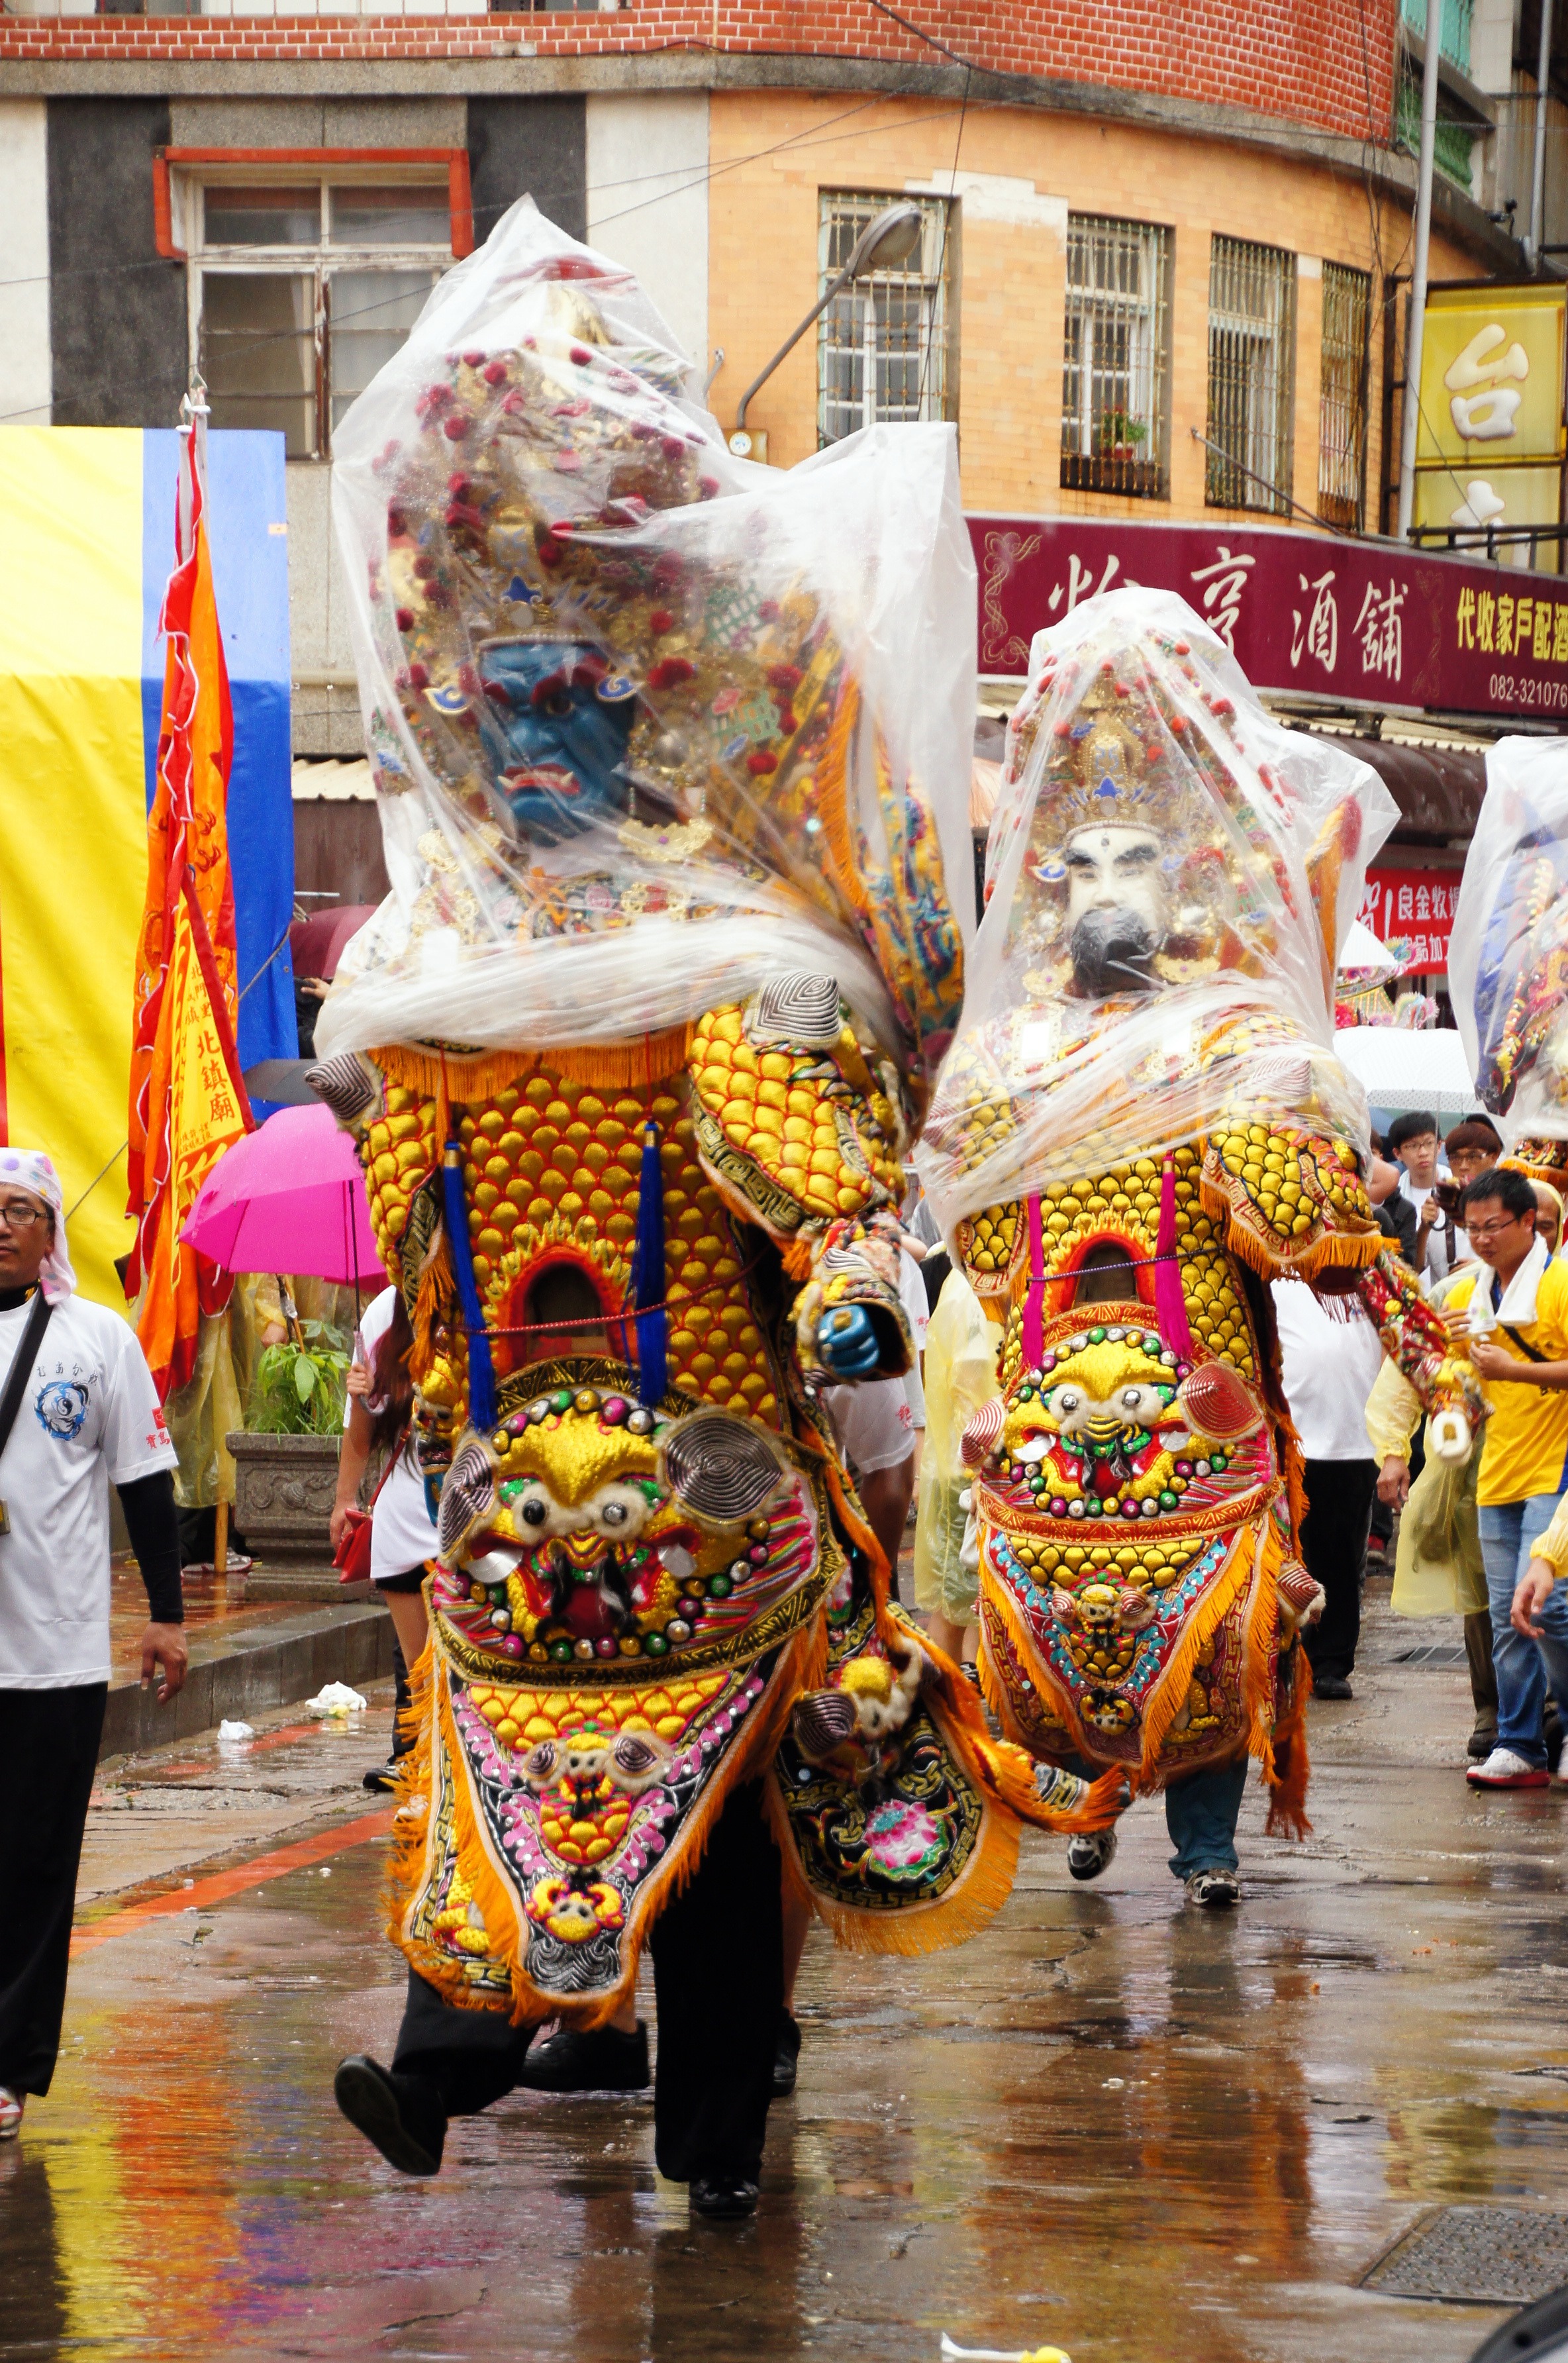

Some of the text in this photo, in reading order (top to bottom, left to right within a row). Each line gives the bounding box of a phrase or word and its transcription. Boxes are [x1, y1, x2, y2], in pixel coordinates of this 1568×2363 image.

[1490, 674, 1568, 709] 082-321076
[198, 1031, 234, 1122] 北鎮廟
